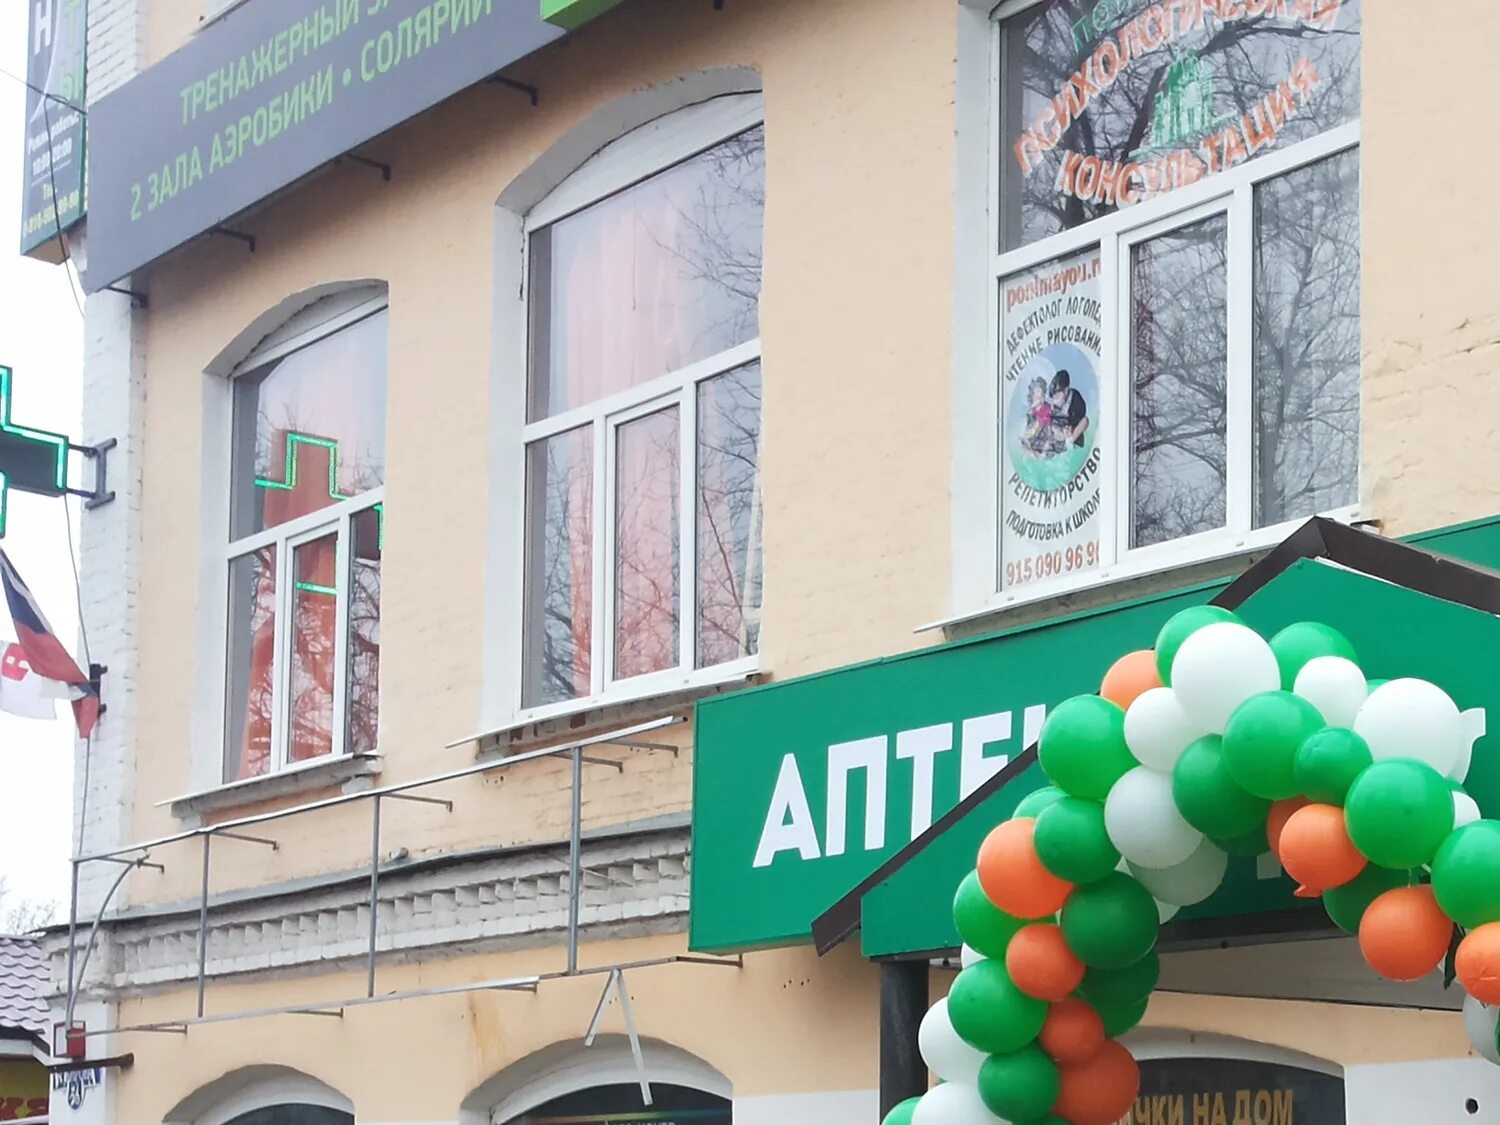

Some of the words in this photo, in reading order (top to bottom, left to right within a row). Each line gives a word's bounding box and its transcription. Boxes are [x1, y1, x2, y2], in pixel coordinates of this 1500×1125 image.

[130, 183, 142, 222] 2
[147, 145, 204, 212] ЗАЛА
[208, 63, 334, 175] АЭРОБИКИ
[1053, 56, 1322, 207] КОНСУЛЬТАЦИЯ
[1006, 298, 1062, 357] ДЕФЕКТОЛОГ
[1006, 336, 1043, 383] ЧТЕНИЕ
[1005, 509, 1064, 541] ПОДГОТОВКА
[1064, 516, 1073, 536] К
[1006, 557, 1032, 586] 915
[1035, 550, 1062, 579] 090
[1065, 543, 1084, 572] 96
